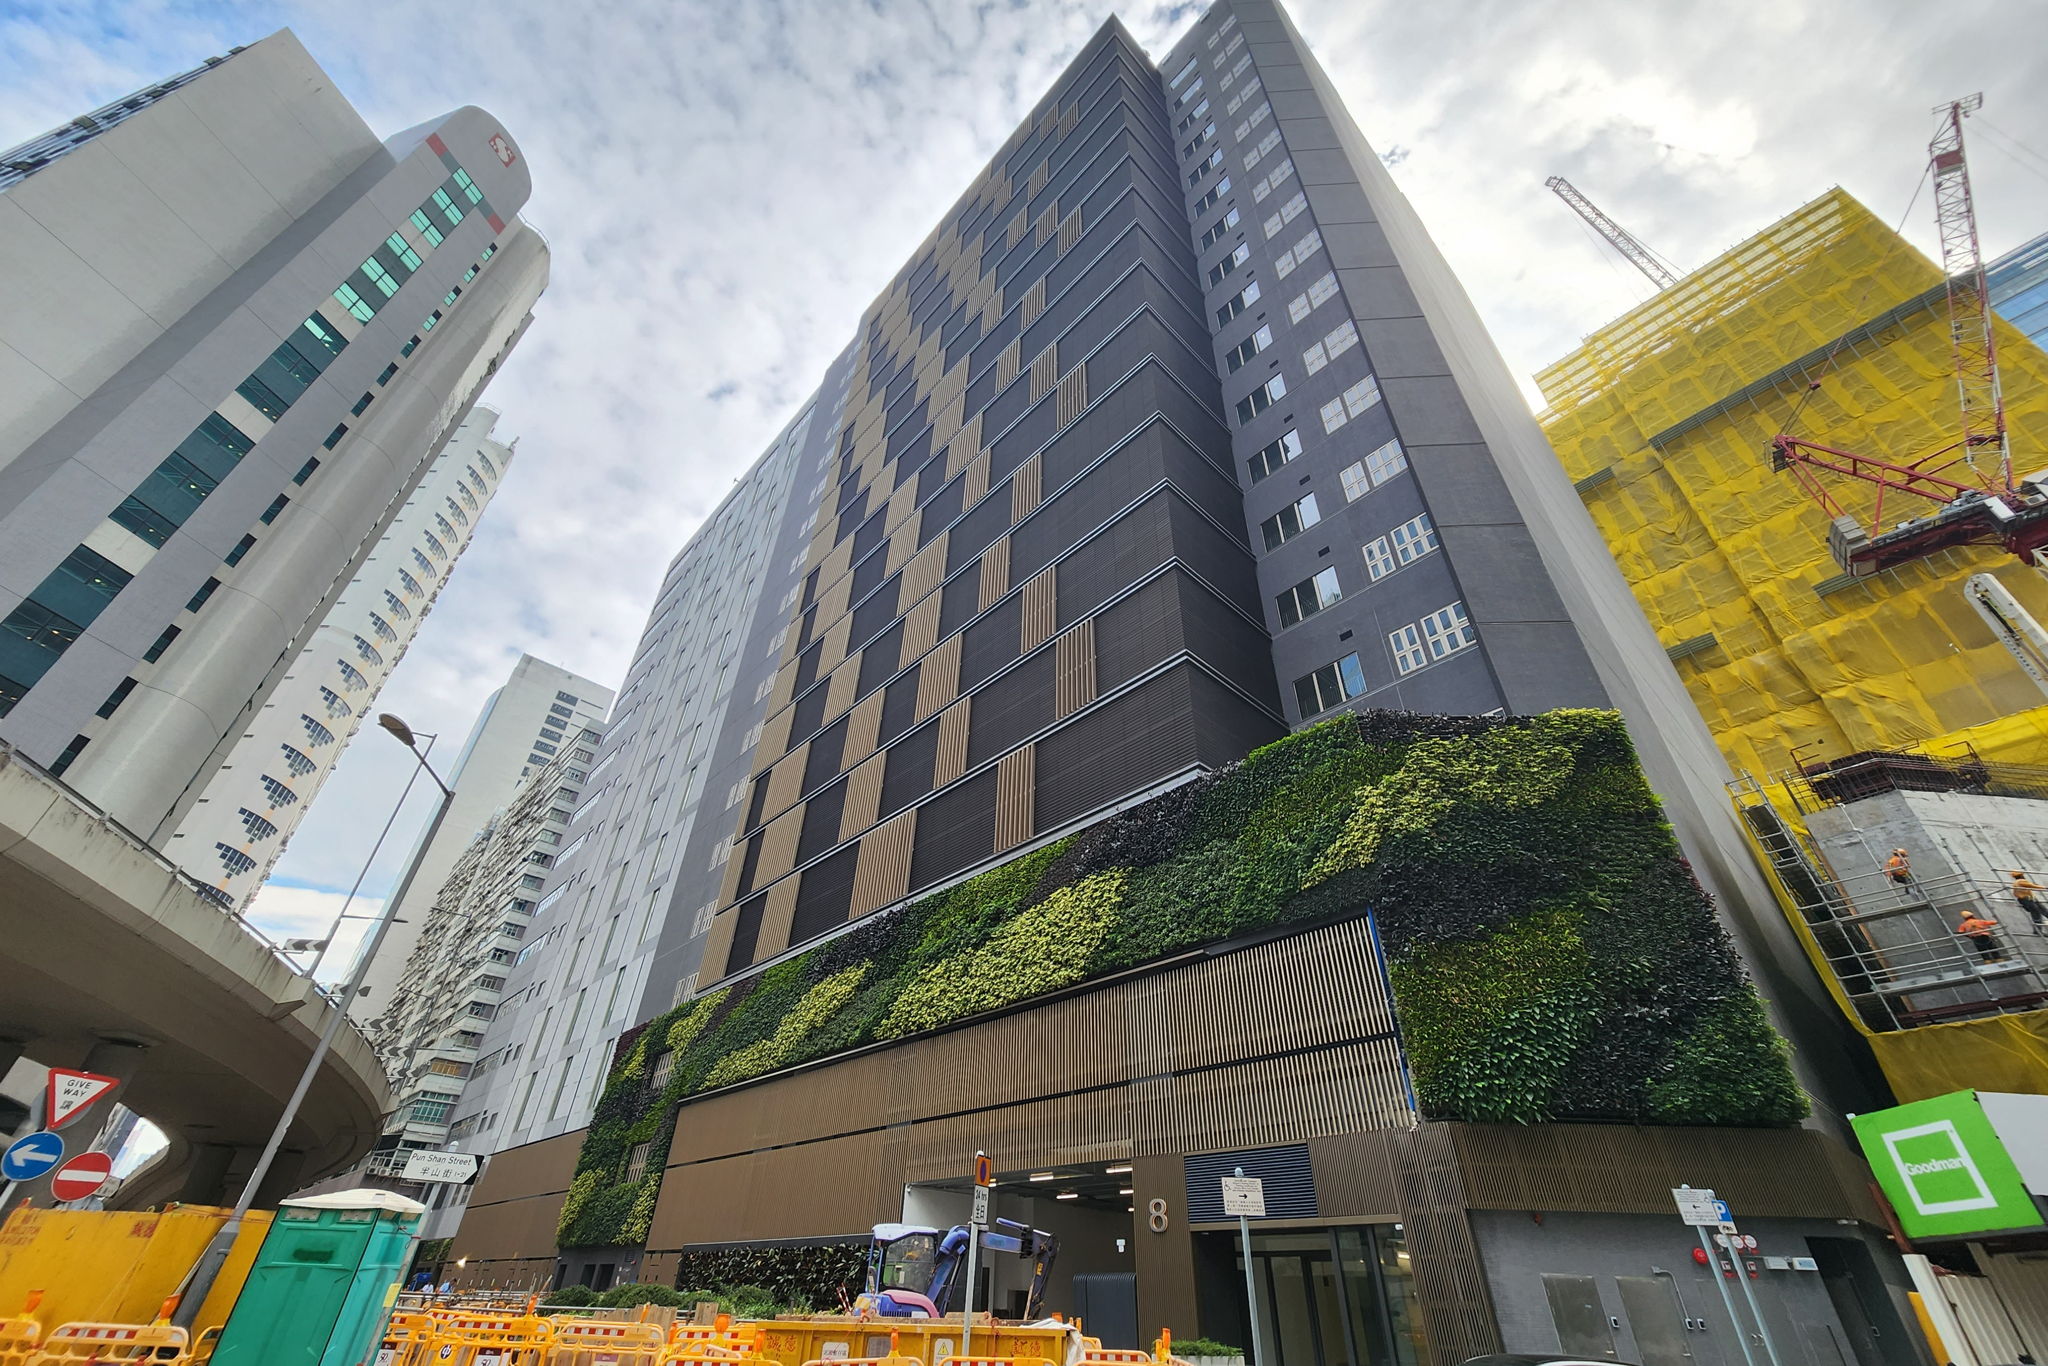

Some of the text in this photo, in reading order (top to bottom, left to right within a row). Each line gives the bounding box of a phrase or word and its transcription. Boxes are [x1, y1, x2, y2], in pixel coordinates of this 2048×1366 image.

[67, 1079, 93, 1089] GIVE
[63, 1088, 87, 1097] WAY
[411, 1153, 472, 1166] Pun Shan Street
[1904, 1158, 1967, 1176] Goodman
[1149, 1198, 1168, 1232] 8
[1713, 1202, 1726, 1220] P
